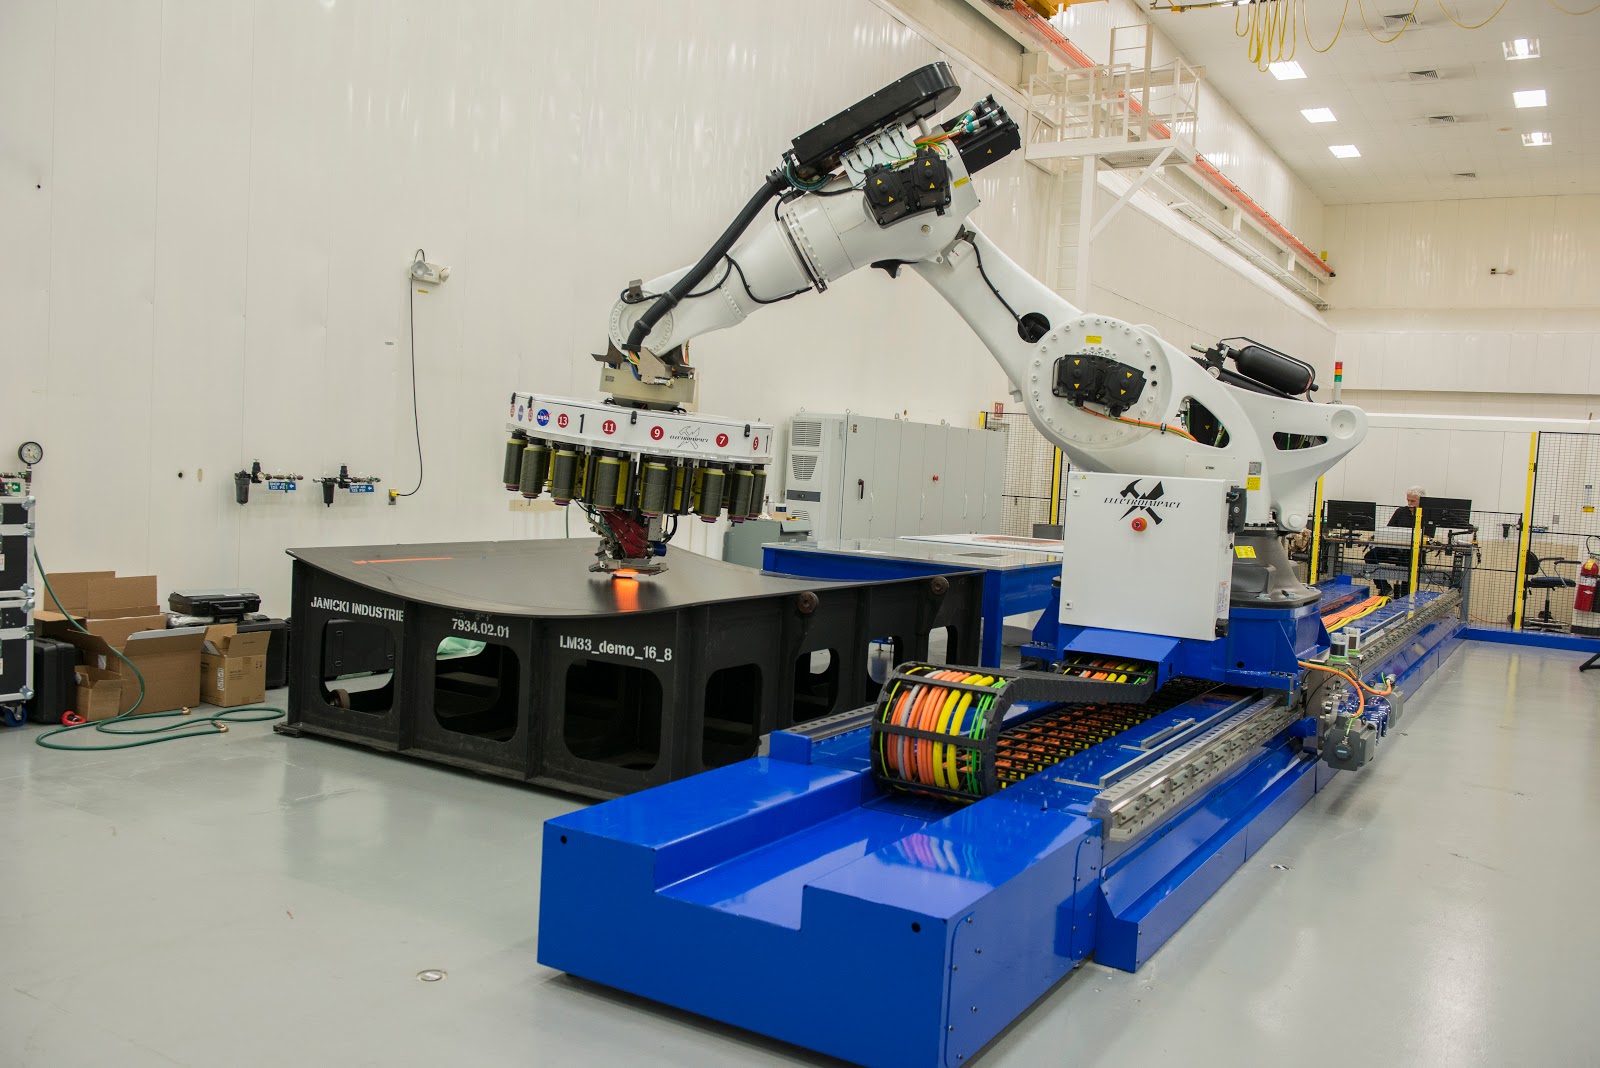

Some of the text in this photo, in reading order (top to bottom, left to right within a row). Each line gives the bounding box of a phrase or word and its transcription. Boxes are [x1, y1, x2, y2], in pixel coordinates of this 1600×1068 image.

[558, 415, 568, 425] 13
[603, 423, 615, 432] 11
[1104, 497, 1181, 508] ELECTROIMPACT
[311, 596, 404, 622] JANICKI INDUSTRIE
[452, 618, 509, 638] 7934.02.01
[560, 635, 672, 662] LM33_demo_16_8
